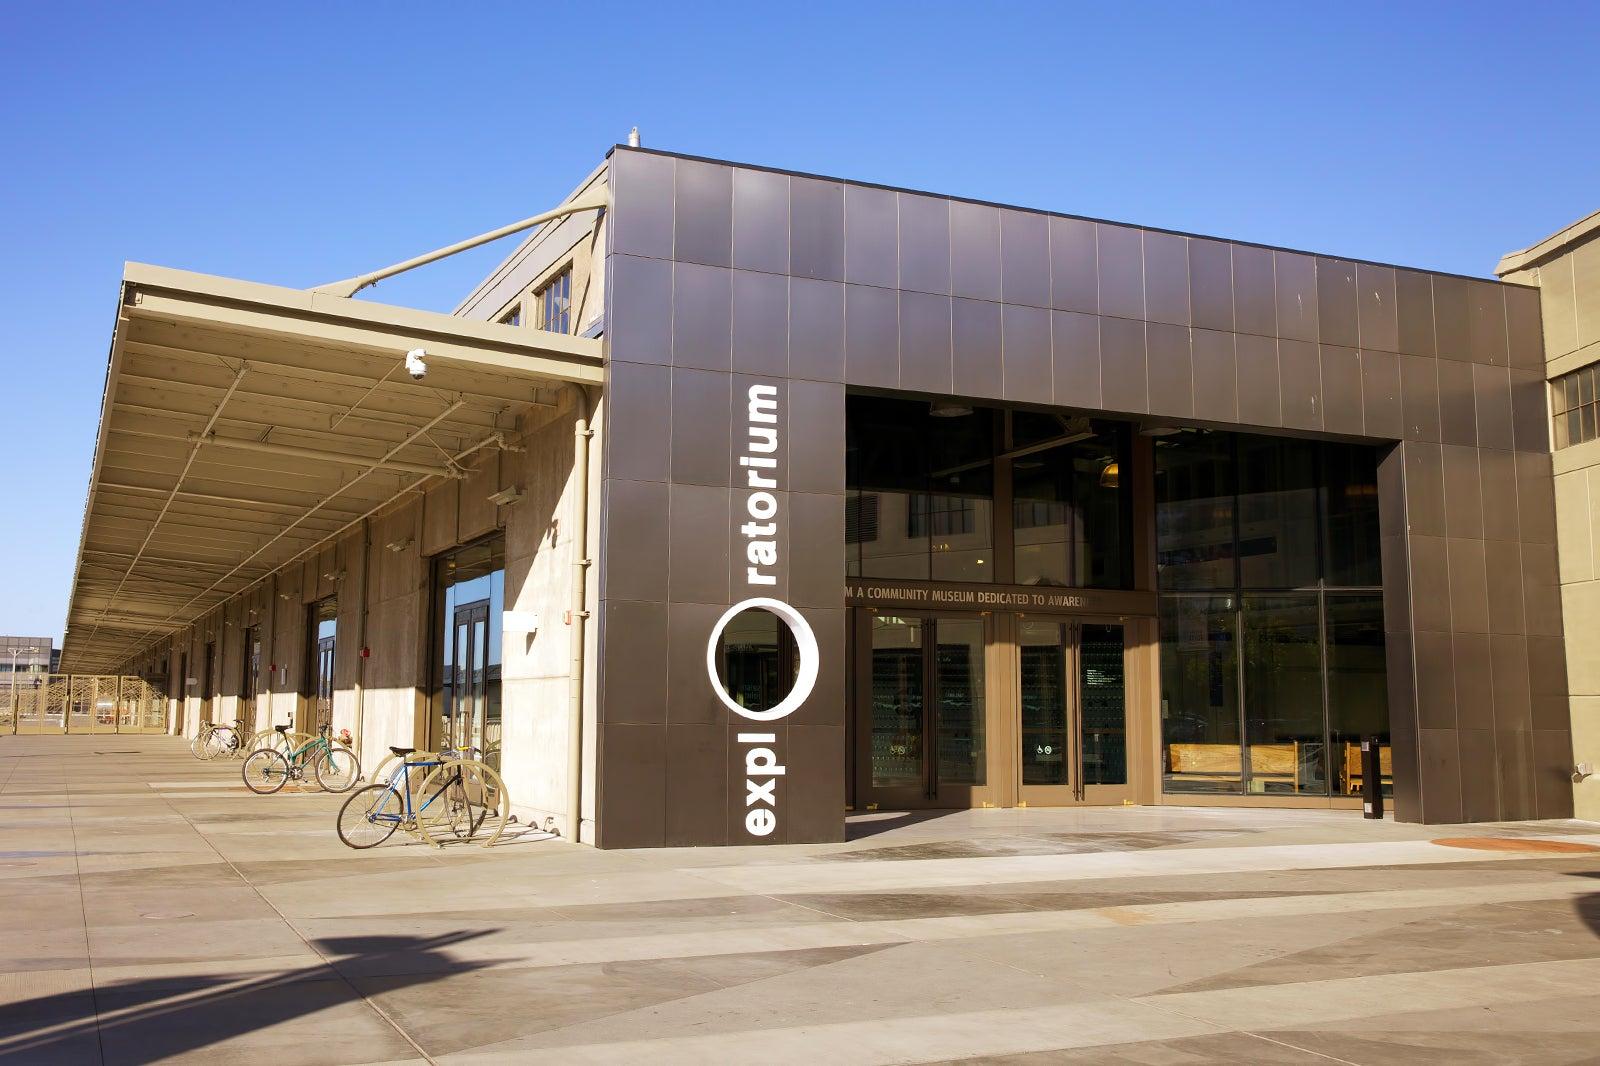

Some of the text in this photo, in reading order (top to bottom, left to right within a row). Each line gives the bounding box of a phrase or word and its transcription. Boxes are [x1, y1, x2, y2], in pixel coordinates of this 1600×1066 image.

[857, 586, 864, 598] A
[867, 587, 929, 601] COMMUNITY
[932, 590, 975, 603] MUSEUM
[977, 591, 1029, 605] DEDICATED
[1031, 594, 1045, 606] TO
